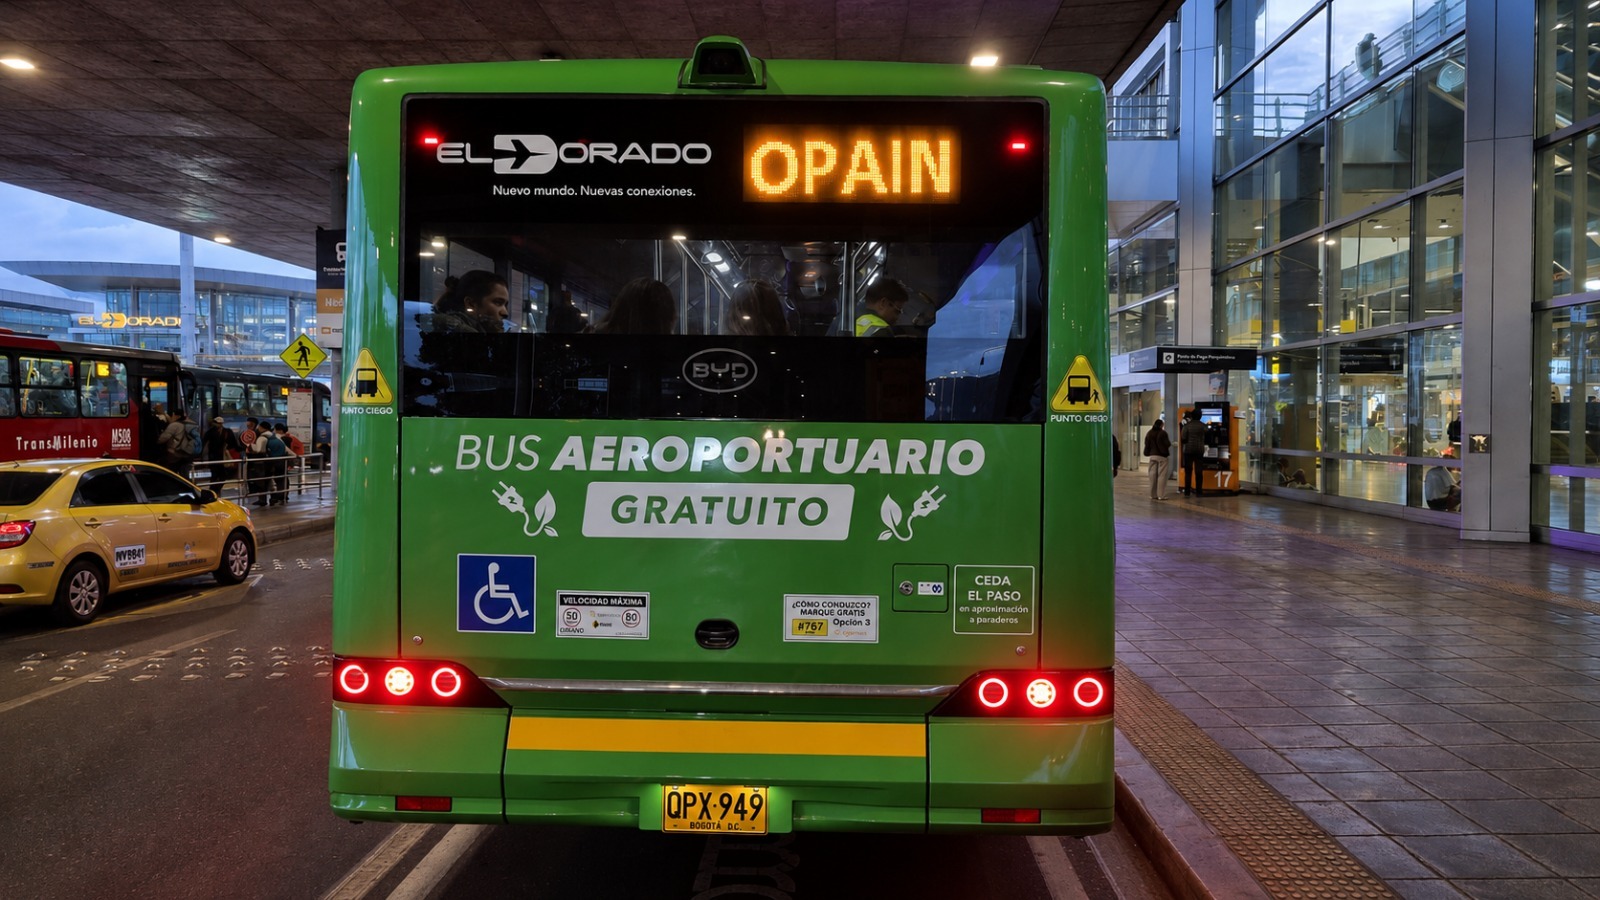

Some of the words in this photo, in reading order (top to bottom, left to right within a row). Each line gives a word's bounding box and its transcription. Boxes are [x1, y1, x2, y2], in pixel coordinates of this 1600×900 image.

[437, 143, 493, 163] EL
[494, 135, 711, 174] DORADO
[751, 140, 950, 194] OPAIN
[493, 185, 531, 196] Nuevo
[534, 185, 578, 196] mundo.
[581, 185, 624, 197] Nuevas
[626, 185, 696, 197] conexiones.
[102, 312, 181, 328] DORAD
[693, 362, 748, 378] BYD
[1050, 414, 1082, 422] PUNTO
[1084, 414, 1108, 423] CIEGO
[112, 428, 131, 444] M508
[16, 435, 98, 450] TransMilenio
[455, 434, 542, 472] BUS
[549, 436, 986, 476] AEROPORTUARIO
[1214, 471, 1233, 487] 17
[610, 495, 829, 527] GRATUITO
[974, 575, 1012, 586] CEDA
[967, 590, 983, 601] EL
[986, 590, 1021, 601] PASO
[562, 597, 609, 605] VELOCIDAD
[610, 597, 643, 606] MÁXIMA
[792, 600, 820, 608] ¿CÓMO
[800, 608, 835, 616] MARQUE
[836, 609, 866, 617] GRATIS
[971, 605, 1029, 614] aproximación
[566, 611, 578, 621] 50
[625, 612, 638, 622] 80
[976, 616, 1019, 625] paraderos
[798, 621, 824, 631] #767
[832, 618, 863, 628] Opción
[865, 619, 871, 627] 3
